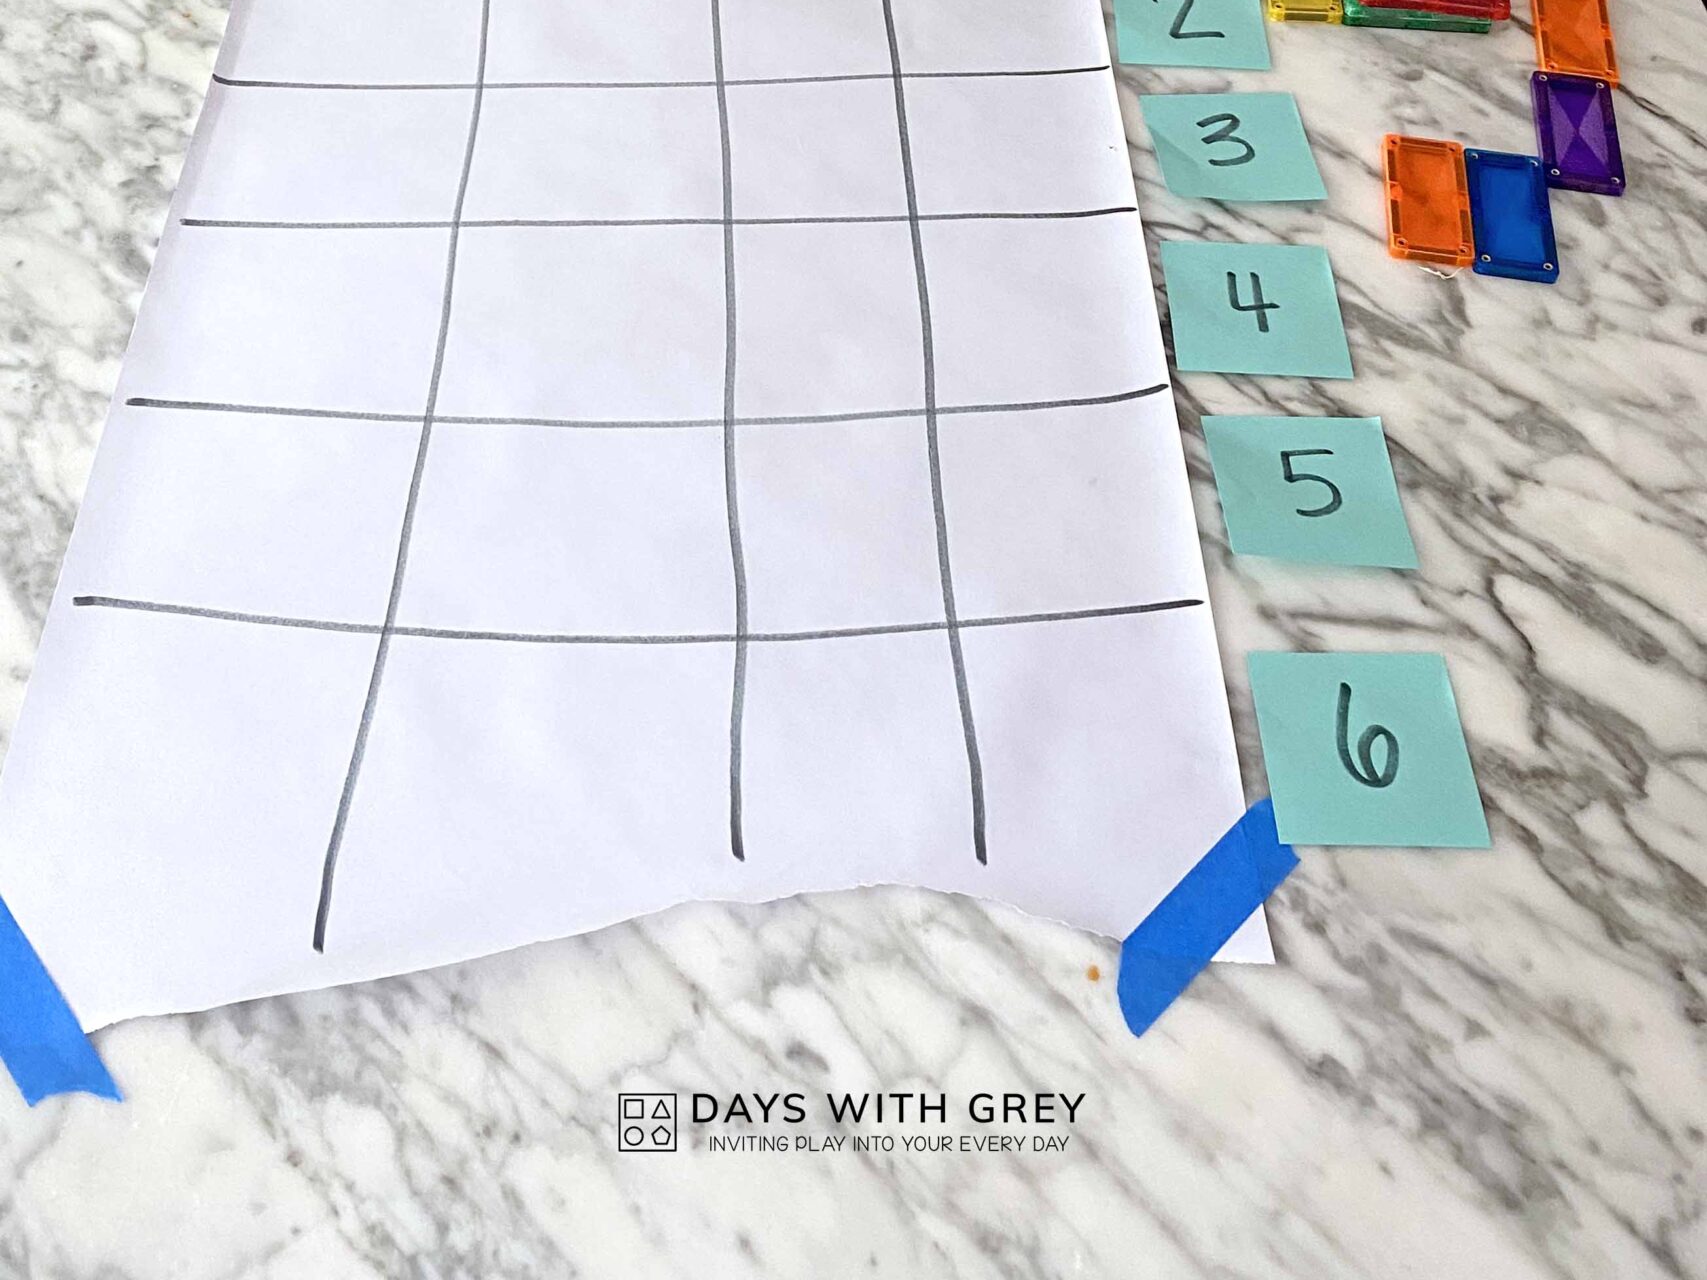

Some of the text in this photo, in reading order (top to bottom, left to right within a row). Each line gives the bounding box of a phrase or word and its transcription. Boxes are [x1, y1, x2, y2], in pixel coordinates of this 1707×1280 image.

[1195, 113, 1256, 167] 3
[1226, 271, 1280, 333] 4
[1280, 448, 1343, 518] 5
[1336, 682, 1400, 788] 6
